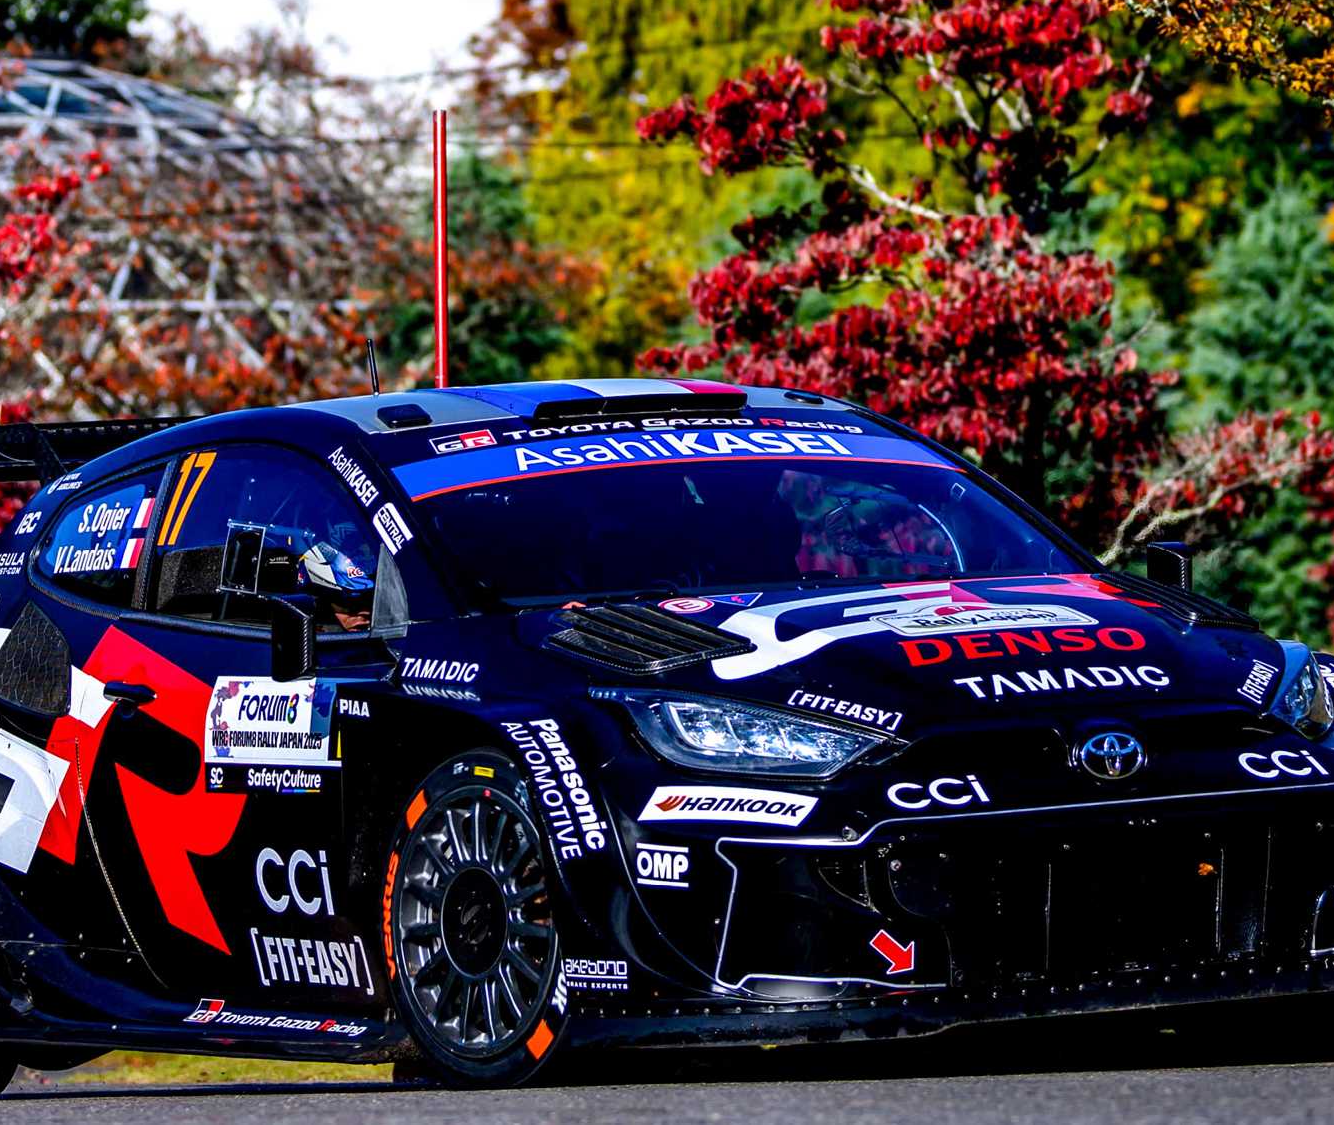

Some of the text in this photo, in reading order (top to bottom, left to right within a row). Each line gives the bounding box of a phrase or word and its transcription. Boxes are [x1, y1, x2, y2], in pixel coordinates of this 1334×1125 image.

[436, 418, 863, 453] GR TOYOTA GAZOO Racing
[515, 432, 853, 472] AsahiKASEI
[328, 446, 379, 507] AsahiKASEI
[157, 452, 217, 547] 17
[78, 502, 132, 537] S.Ogier
[377, 506, 405, 550] CENTRAL
[53, 542, 116, 574] V.Landais
[897, 628, 1147, 667] DENSO
[401, 657, 479, 683] TAMADIC
[955, 664, 1170, 700] TAMADIC
[238, 693, 300, 724] FORUM8
[339, 699, 370, 718] PIAA
[212, 731, 322, 750] WRC FORUM8 RALLY JAPAN 2025
[210, 767, 321, 792] SC SafetyCulture
[500, 722, 583, 860] AUTOMOTIVE
[528, 718, 608, 850] Panasonic
[636, 850, 689, 880] OMP
[566, 959, 627, 975] akebono
[216, 1011, 270, 1025] TOYOTA
[267, 1016, 321, 1030] GAZOO
[317, 1019, 368, 1037] Racing
